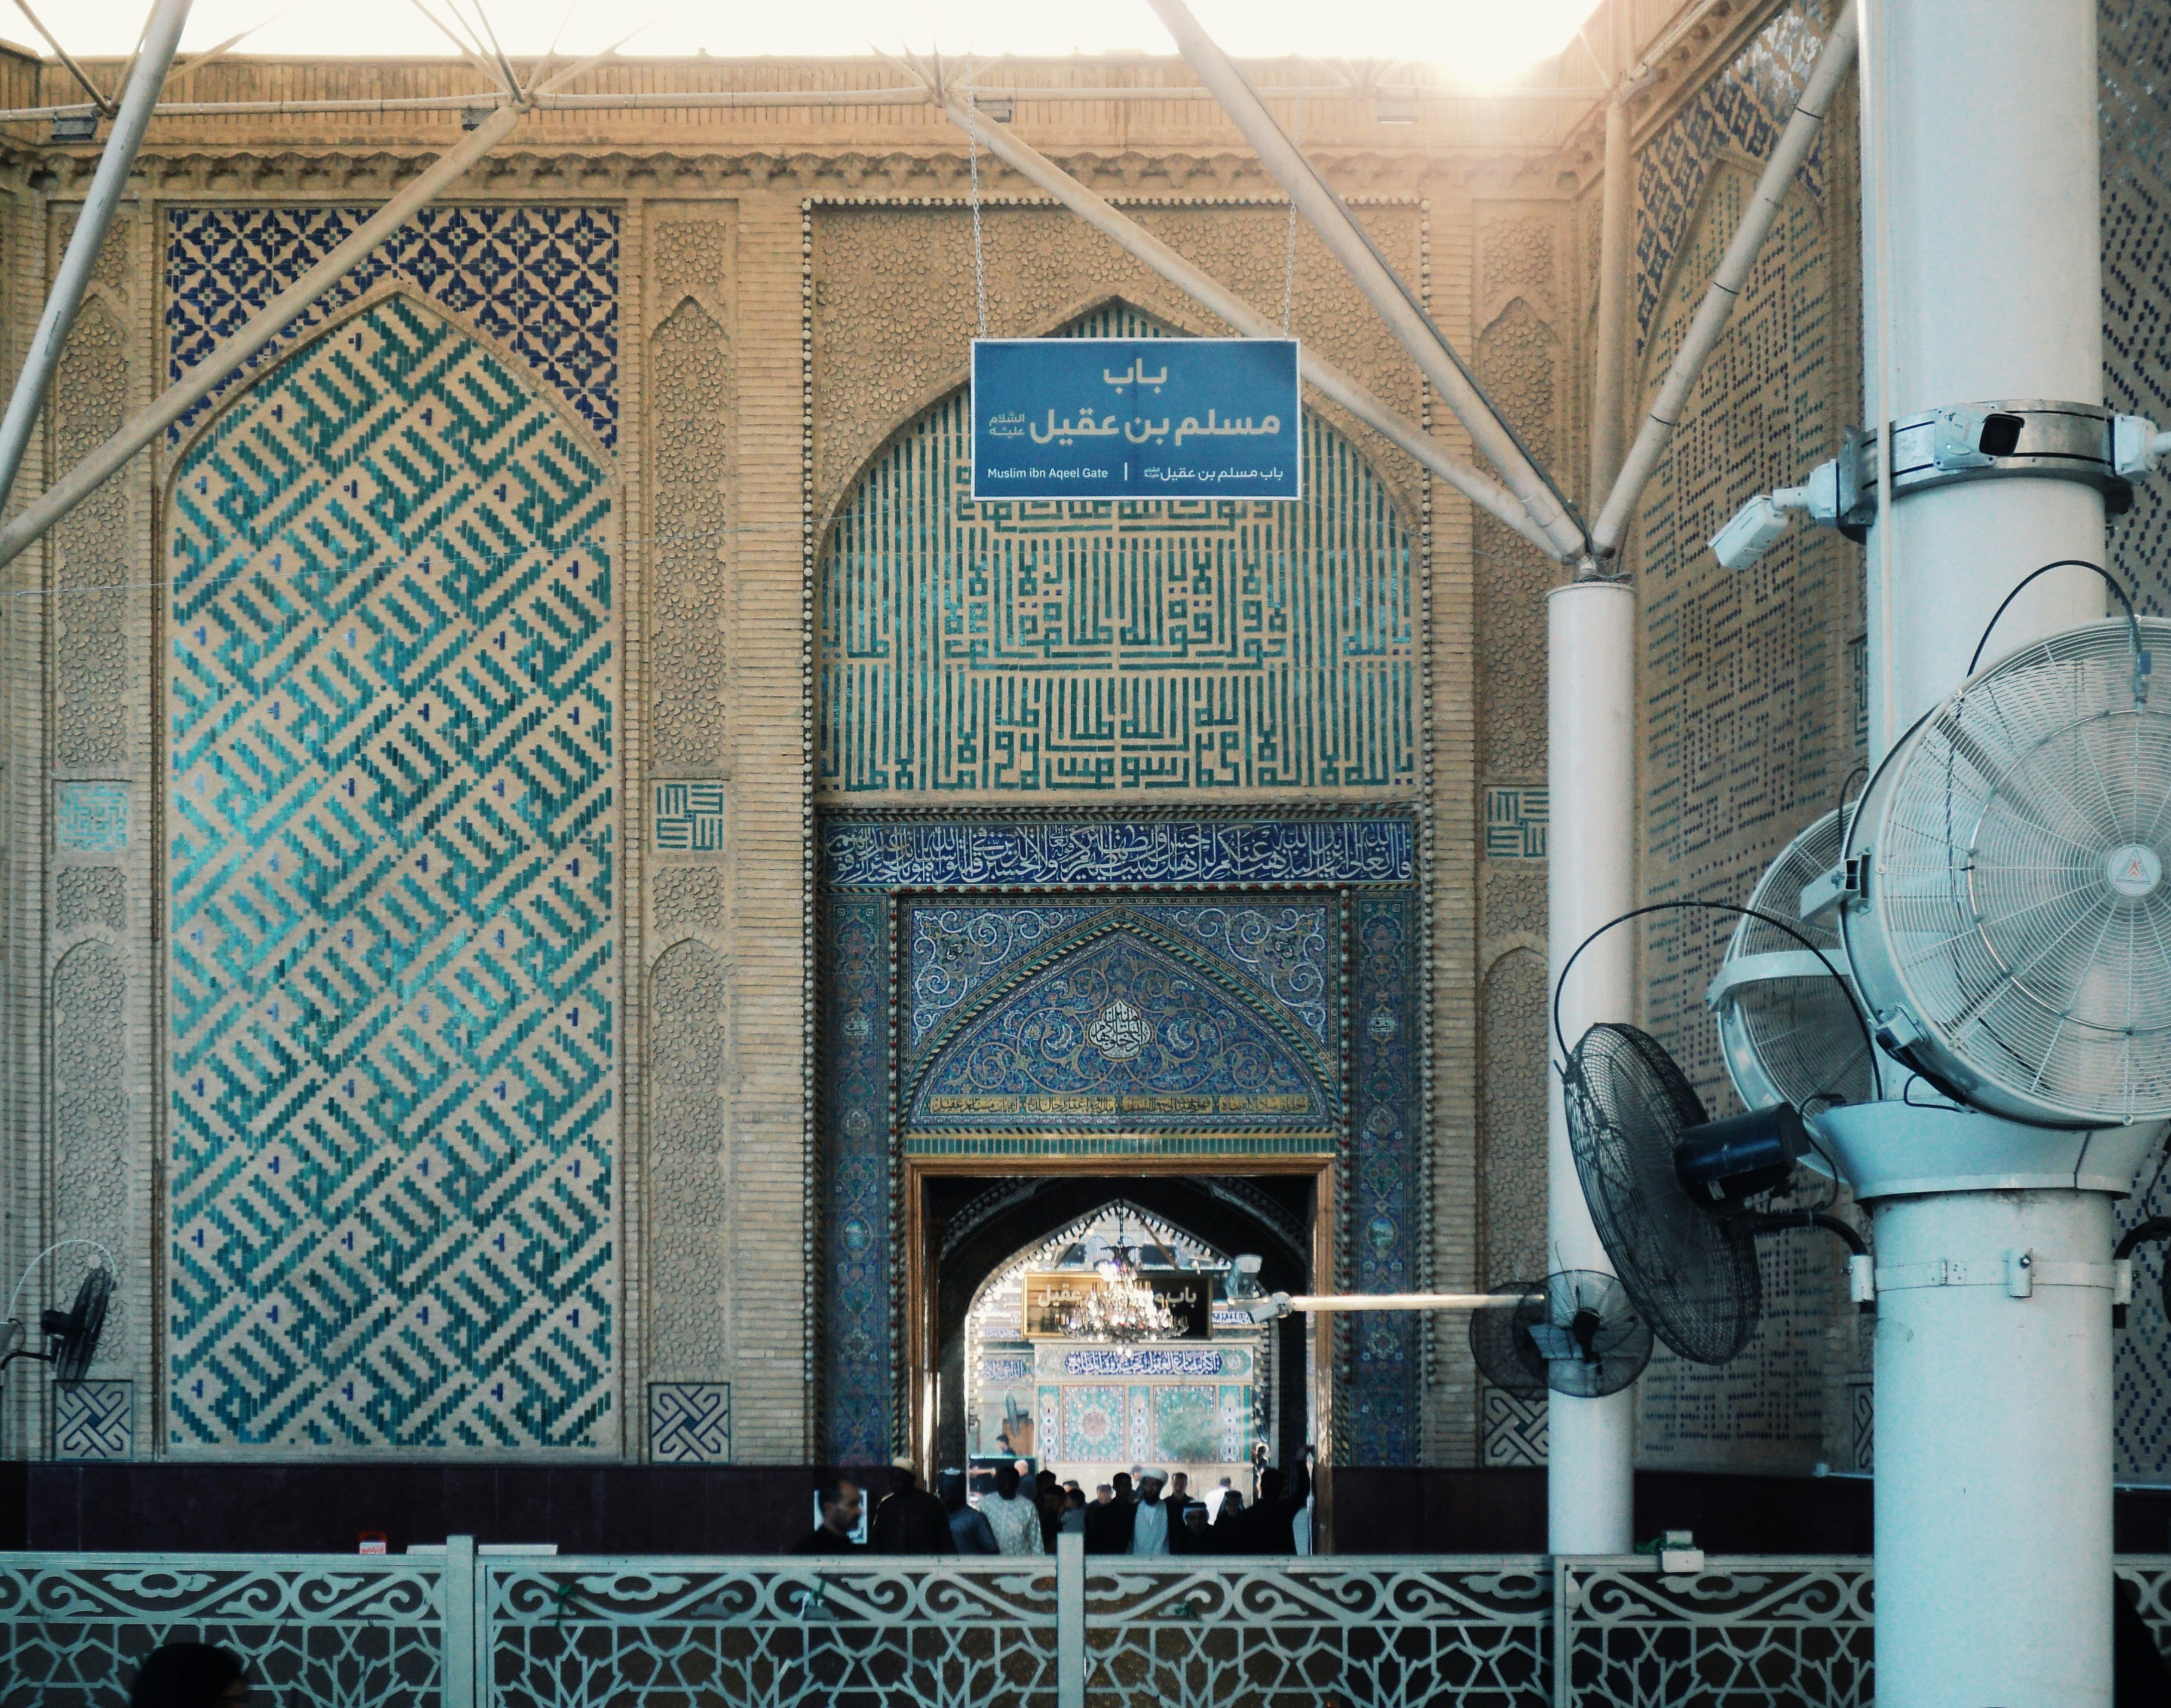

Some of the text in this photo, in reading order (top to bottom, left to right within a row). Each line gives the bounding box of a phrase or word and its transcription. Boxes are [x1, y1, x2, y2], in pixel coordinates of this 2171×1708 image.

[1104, 358, 1167, 394] باب
[1030, 407, 1281, 446] مسلم بن عقيل
[988, 468, 1108, 480] Muslim ibn Aqeel Gate
[1160, 467, 1283, 482] باب مسلم بن عقيل
